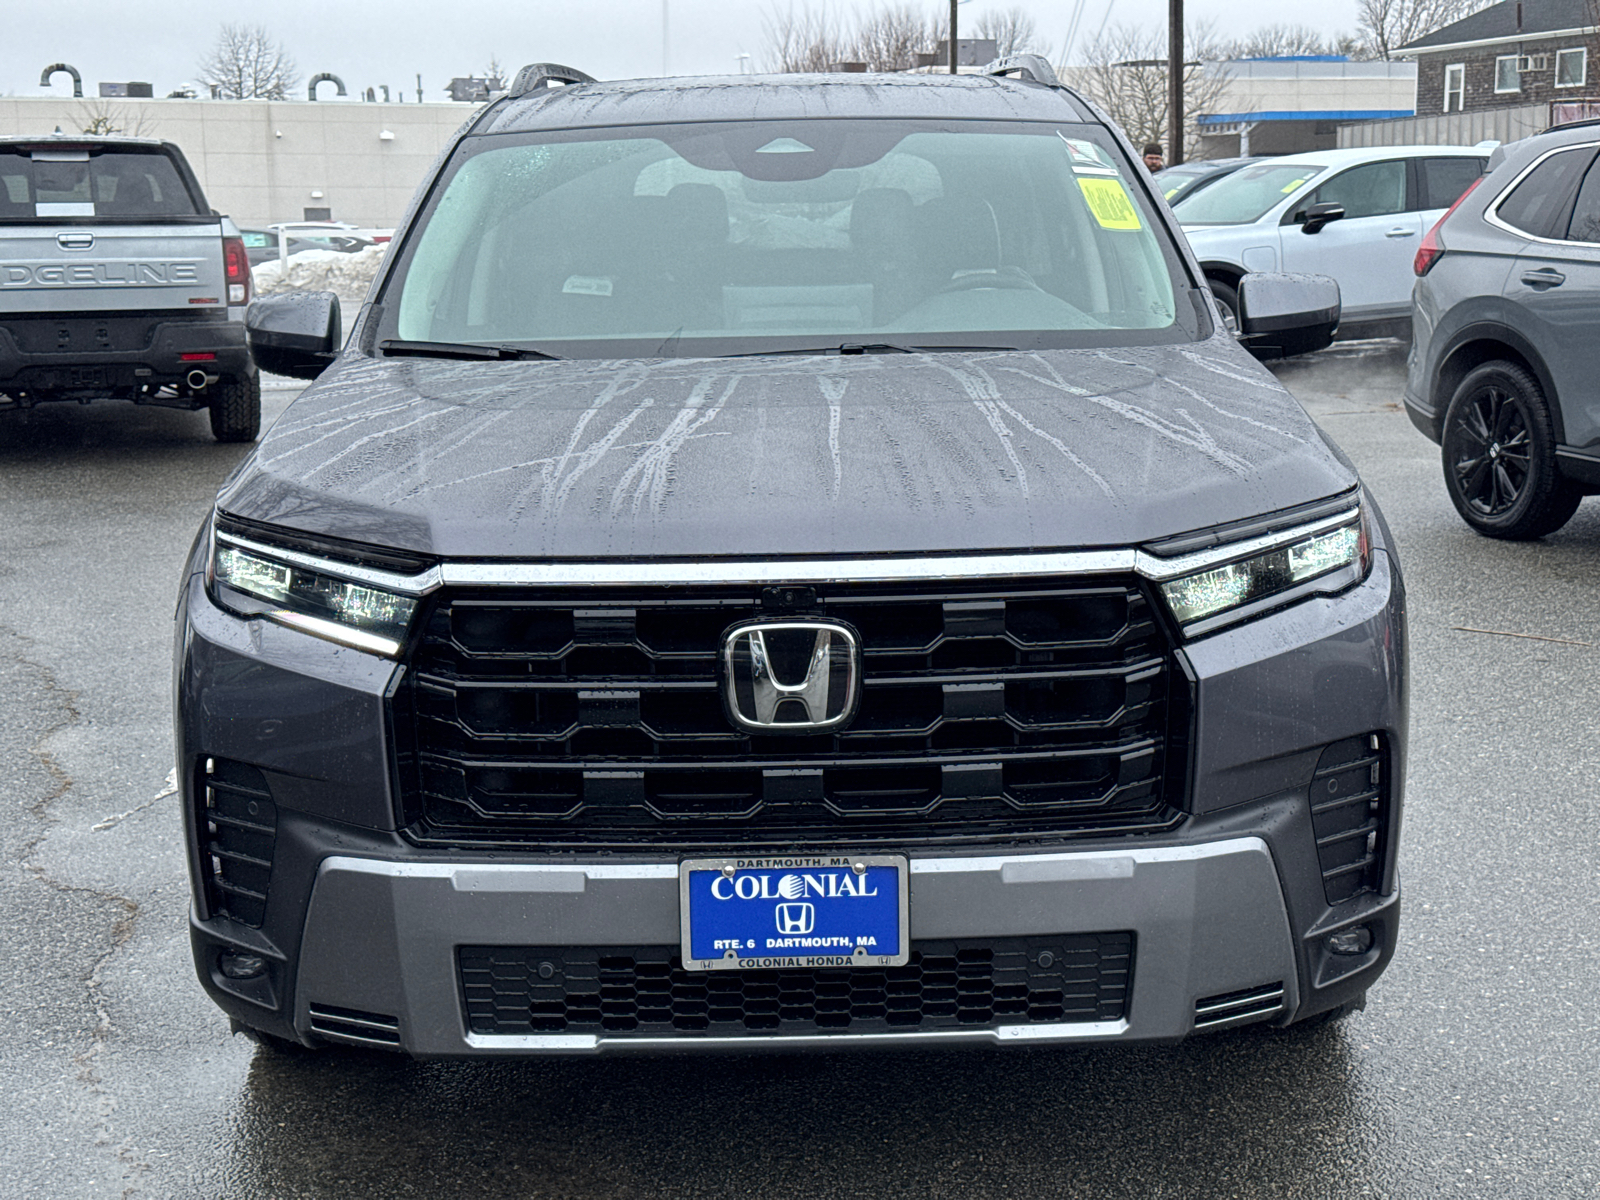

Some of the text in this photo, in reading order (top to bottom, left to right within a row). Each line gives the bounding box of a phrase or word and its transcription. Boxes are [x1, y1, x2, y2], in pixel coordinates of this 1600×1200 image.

[736, 858, 850, 868] DARTMOUTH, MA
[711, 873, 878, 900] COLONIAL
[714, 936, 877, 949] RTE. 6 DARTMOUTH, MA
[738, 956, 854, 968] COLONIAL HONDA
